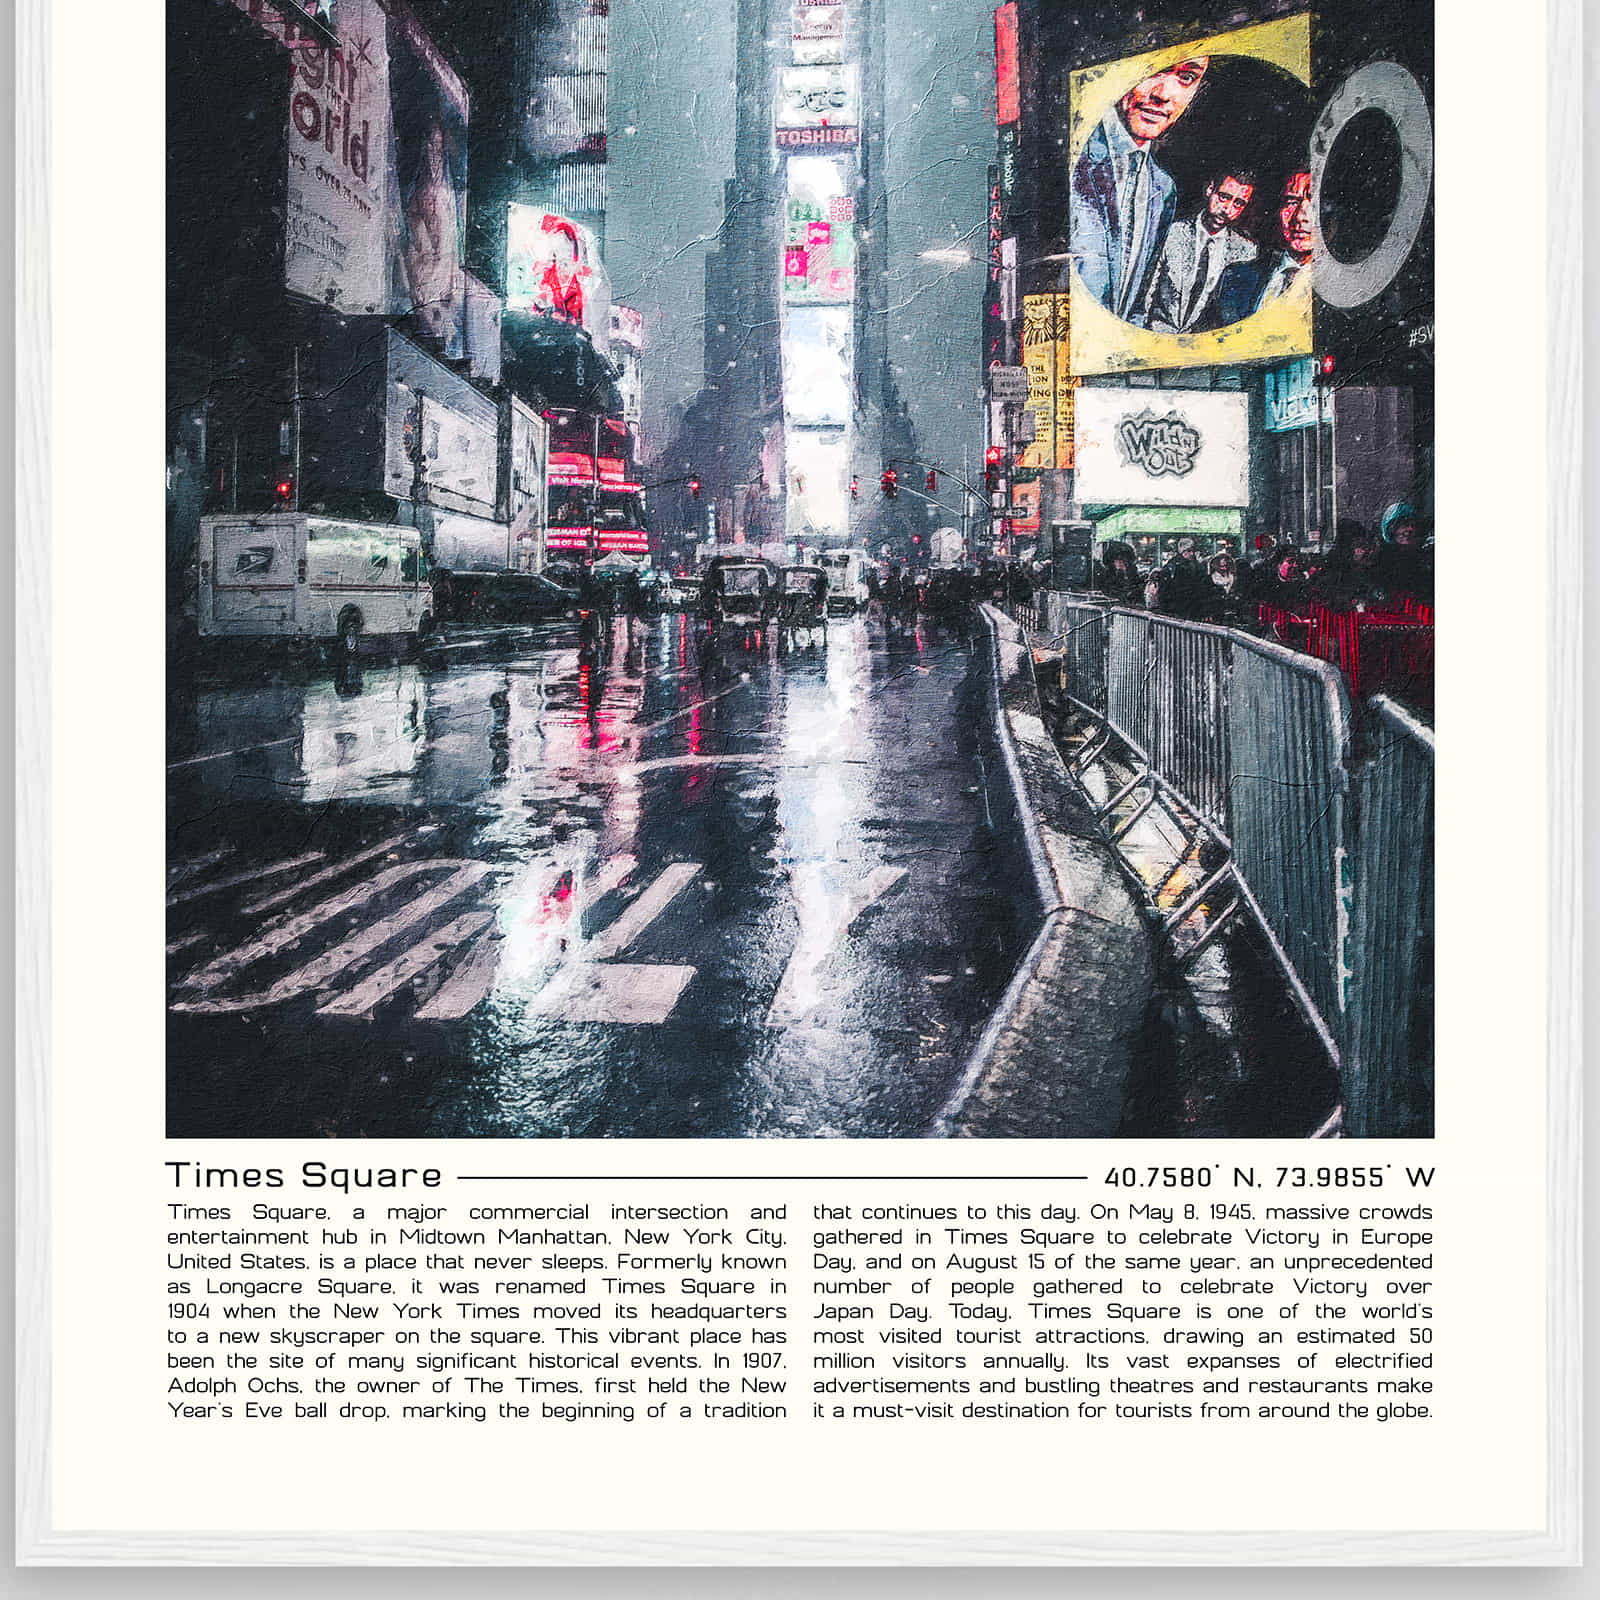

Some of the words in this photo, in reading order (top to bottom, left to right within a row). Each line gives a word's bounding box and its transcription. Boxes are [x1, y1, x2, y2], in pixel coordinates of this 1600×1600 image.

[776, 128, 858, 145] TOSHIBA
[1030, 364, 1046, 373] THE
[164, 1161, 284, 1188] Times
[302, 1161, 441, 1195] Square
[1405, 1167, 1436, 1188] W
[167, 1203, 232, 1220] Times
[352, 1207, 365, 1220] a
[387, 1203, 448, 1224] major
[469, 1203, 589, 1220] commercial
[611, 1203, 729, 1220] intersection
[750, 1203, 787, 1220] and
[167, 1228, 310, 1245] entertainment
[322, 1228, 358, 1245] hub
[370, 1228, 387, 1245] in
[399, 1228, 486, 1245] Midtown
[624, 1228, 670, 1245] New
[682, 1228, 733, 1245] York
[813, 1228, 903, 1249] gathered
[915, 1228, 932, 1245] in
[943, 1228, 1009, 1245] Times
[1020, 1228, 1095, 1249] Square
[1107, 1229, 1127, 1245] to
[1138, 1227, 1233, 1245] celebrate
[1244, 1228, 1320, 1249] Victory
[1332, 1228, 1349, 1245] in
[1361, 1228, 1433, 1249] Europe
[167, 1252, 232, 1270] United
[319, 1252, 335, 1270] is
[343, 1257, 356, 1270] a
[365, 1252, 417, 1274] place
[426, 1252, 465, 1270] that
[474, 1257, 533, 1270] never
[541, 1252, 608, 1274] sleeps.
[617, 1252, 712, 1274] Formerly
[721, 1252, 787, 1270] known
[167, 1281, 191, 1295] as
[206, 1277, 303, 1299] Longacre
[411, 1277, 424, 1295] it
[438, 1281, 480, 1295] was
[495, 1277, 586, 1295] renamed
[601, 1277, 666, 1295] Times
[680, 1277, 755, 1299] Square
[770, 1277, 787, 1295] in
[813, 1277, 893, 1295] number
[911, 1277, 933, 1295] of
[951, 1277, 1015, 1299] people
[1032, 1277, 1123, 1299] gathered
[1142, 1279, 1162, 1294] to
[1180, 1277, 1274, 1295] celebrate
[1292, 1277, 1368, 1299] Victory
[1386, 1281, 1433, 1295] over
[167, 1302, 210, 1320] 1904
[222, 1302, 276, 1319] when
[289, 1303, 321, 1320] the
[333, 1302, 380, 1320] New
[392, 1302, 443, 1320] York
[455, 1302, 520, 1320] Times
[533, 1302, 601, 1319] moved
[615, 1302, 638, 1319] its
[651, 1302, 787, 1323] headquarters
[812, 1302, 874, 1323] Japan
[889, 1302, 933, 1323] Day.
[1027, 1302, 1092, 1320] Times
[1106, 1302, 1181, 1323] Square
[1196, 1302, 1212, 1320] is
[1227, 1306, 1264, 1319] one
[1279, 1302, 1300, 1319] of
[1315, 1303, 1347, 1320] the
[813, 1329, 865, 1344] most
[878, 1327, 942, 1345] visited
[956, 1327, 1022, 1344] tourist
[1163, 1327, 1244, 1348] drawing
[1258, 1331, 1283, 1344] an
[1296, 1327, 1395, 1345] estimated
[1409, 1327, 1433, 1344] 50
[167, 1351, 215, 1369] been
[226, 1352, 258, 1369] the
[268, 1352, 304, 1369] site
[315, 1352, 337, 1369] of
[348, 1356, 405, 1373] many
[416, 1352, 518, 1373] significant
[528, 1352, 619, 1369] historical
[630, 1353, 702, 1369] events.
[714, 1351, 730, 1369] In
[813, 1352, 875, 1369] million
[892, 1352, 967, 1369] visitors
[983, 1352, 1069, 1373] annually.
[1086, 1352, 1110, 1369] Its
[1126, 1353, 1170, 1369] vast
[1186, 1356, 1281, 1373] expanses
[1297, 1352, 1319, 1369] of
[1335, 1351, 1433, 1369] electrified
[813, 1376, 971, 1394] advertisements
[979, 1377, 1016, 1394] and
[1025, 1376, 1101, 1398] bustling
[1109, 1376, 1194, 1394] theatres
[1202, 1376, 1239, 1394] and
[1248, 1378, 1369, 1394] restaurants
[1377, 1376, 1433, 1394] make
[245, 1401, 283, 1419] Eve
[295, 1401, 327, 1418] ball
[402, 1401, 487, 1423] marking
[499, 1401, 530, 1419] the
[541, 1401, 635, 1423] beginning
[646, 1401, 668, 1419] of
[679, 1405, 692, 1418] a
[704, 1401, 787, 1419] tradition
[813, 1401, 825, 1418] it
[832, 1405, 845, 1418] a
[852, 1401, 955, 1419] must-visit
[962, 1401, 1070, 1419] destination
[1077, 1401, 1108, 1418] for
[1115, 1401, 1193, 1419] tourists
[1199, 1401, 1251, 1419] from
[1258, 1401, 1330, 1419] around
[1338, 1401, 1369, 1419] the
[1376, 1401, 1433, 1423] globe.
